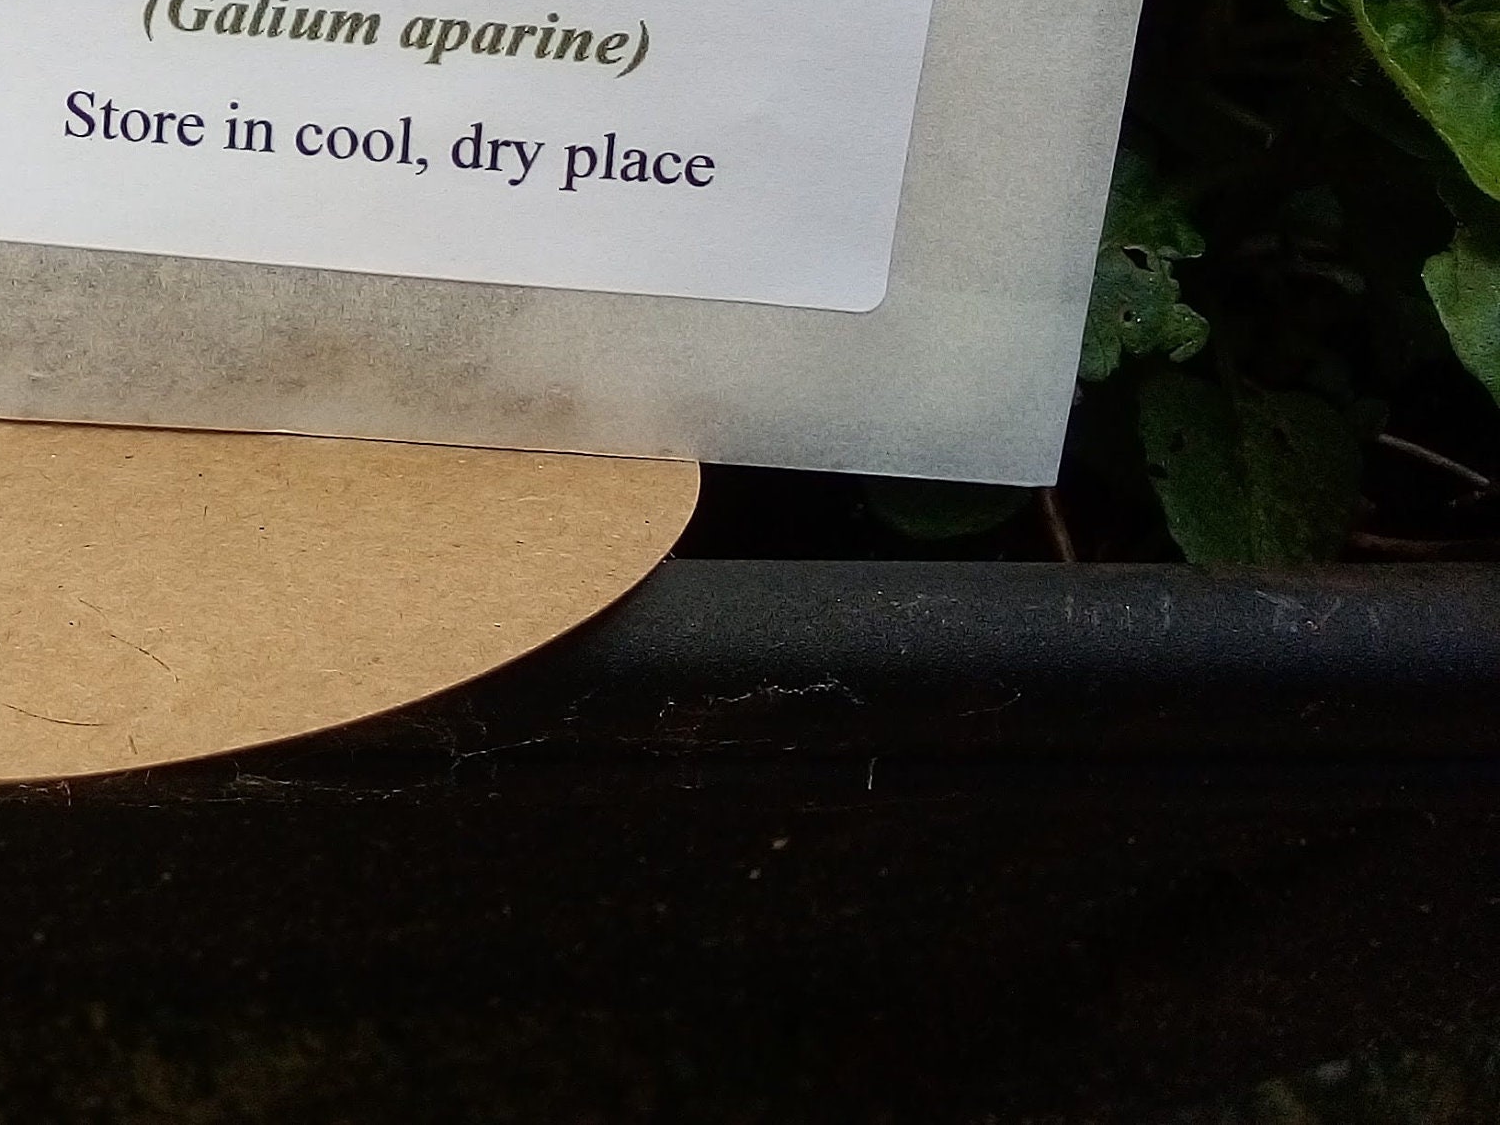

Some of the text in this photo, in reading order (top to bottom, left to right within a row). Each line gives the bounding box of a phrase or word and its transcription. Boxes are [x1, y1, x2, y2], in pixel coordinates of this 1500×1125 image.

[398, 10, 651, 78] aparine)
[64, 89, 717, 193] Store in cool, dry place
